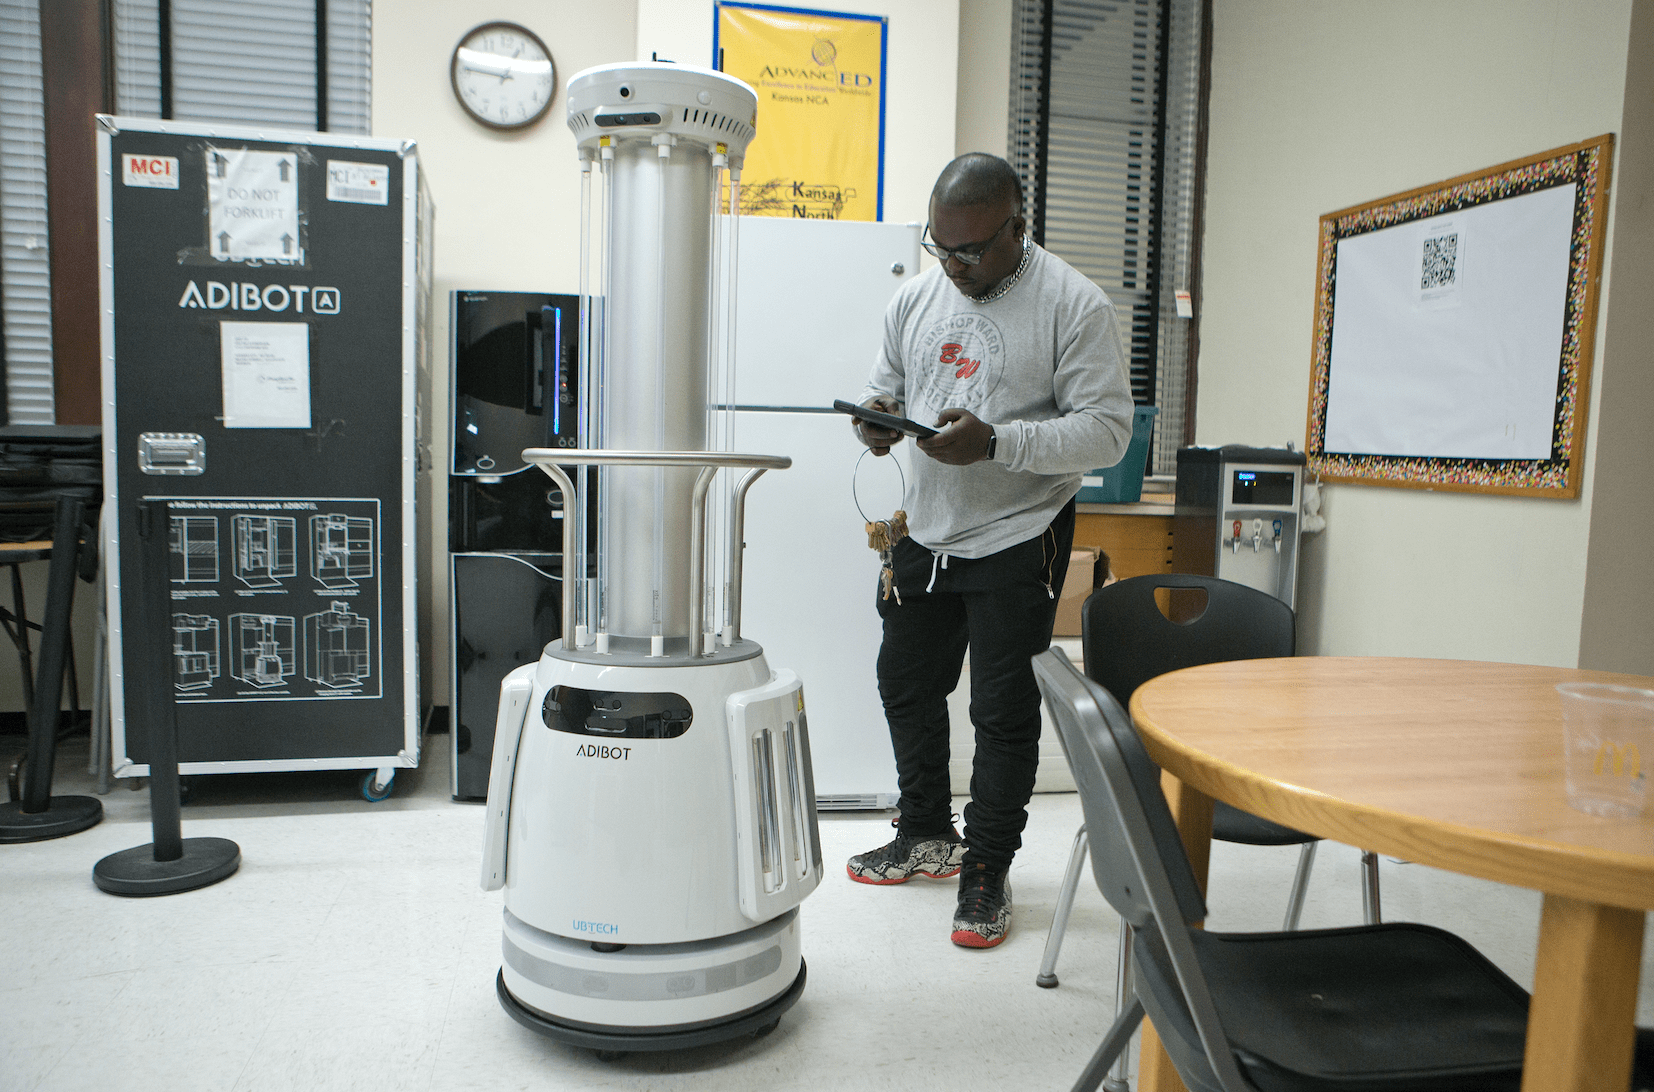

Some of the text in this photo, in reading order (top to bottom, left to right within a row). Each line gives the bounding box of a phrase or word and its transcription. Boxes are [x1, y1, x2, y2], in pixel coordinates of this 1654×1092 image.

[759, 65, 873, 87] ADVANCED
[806, 95, 830, 106] NCA
[131, 158, 171, 176] MCI
[227, 187, 280, 202] DO NOT
[224, 205, 285, 220] FORKLIFT
[178, 279, 310, 314] ADIBOT
[925, 317, 1000, 355] BISHOP WARD
[575, 743, 632, 761] ADIBOT
[572, 919, 619, 935] UBTECH
